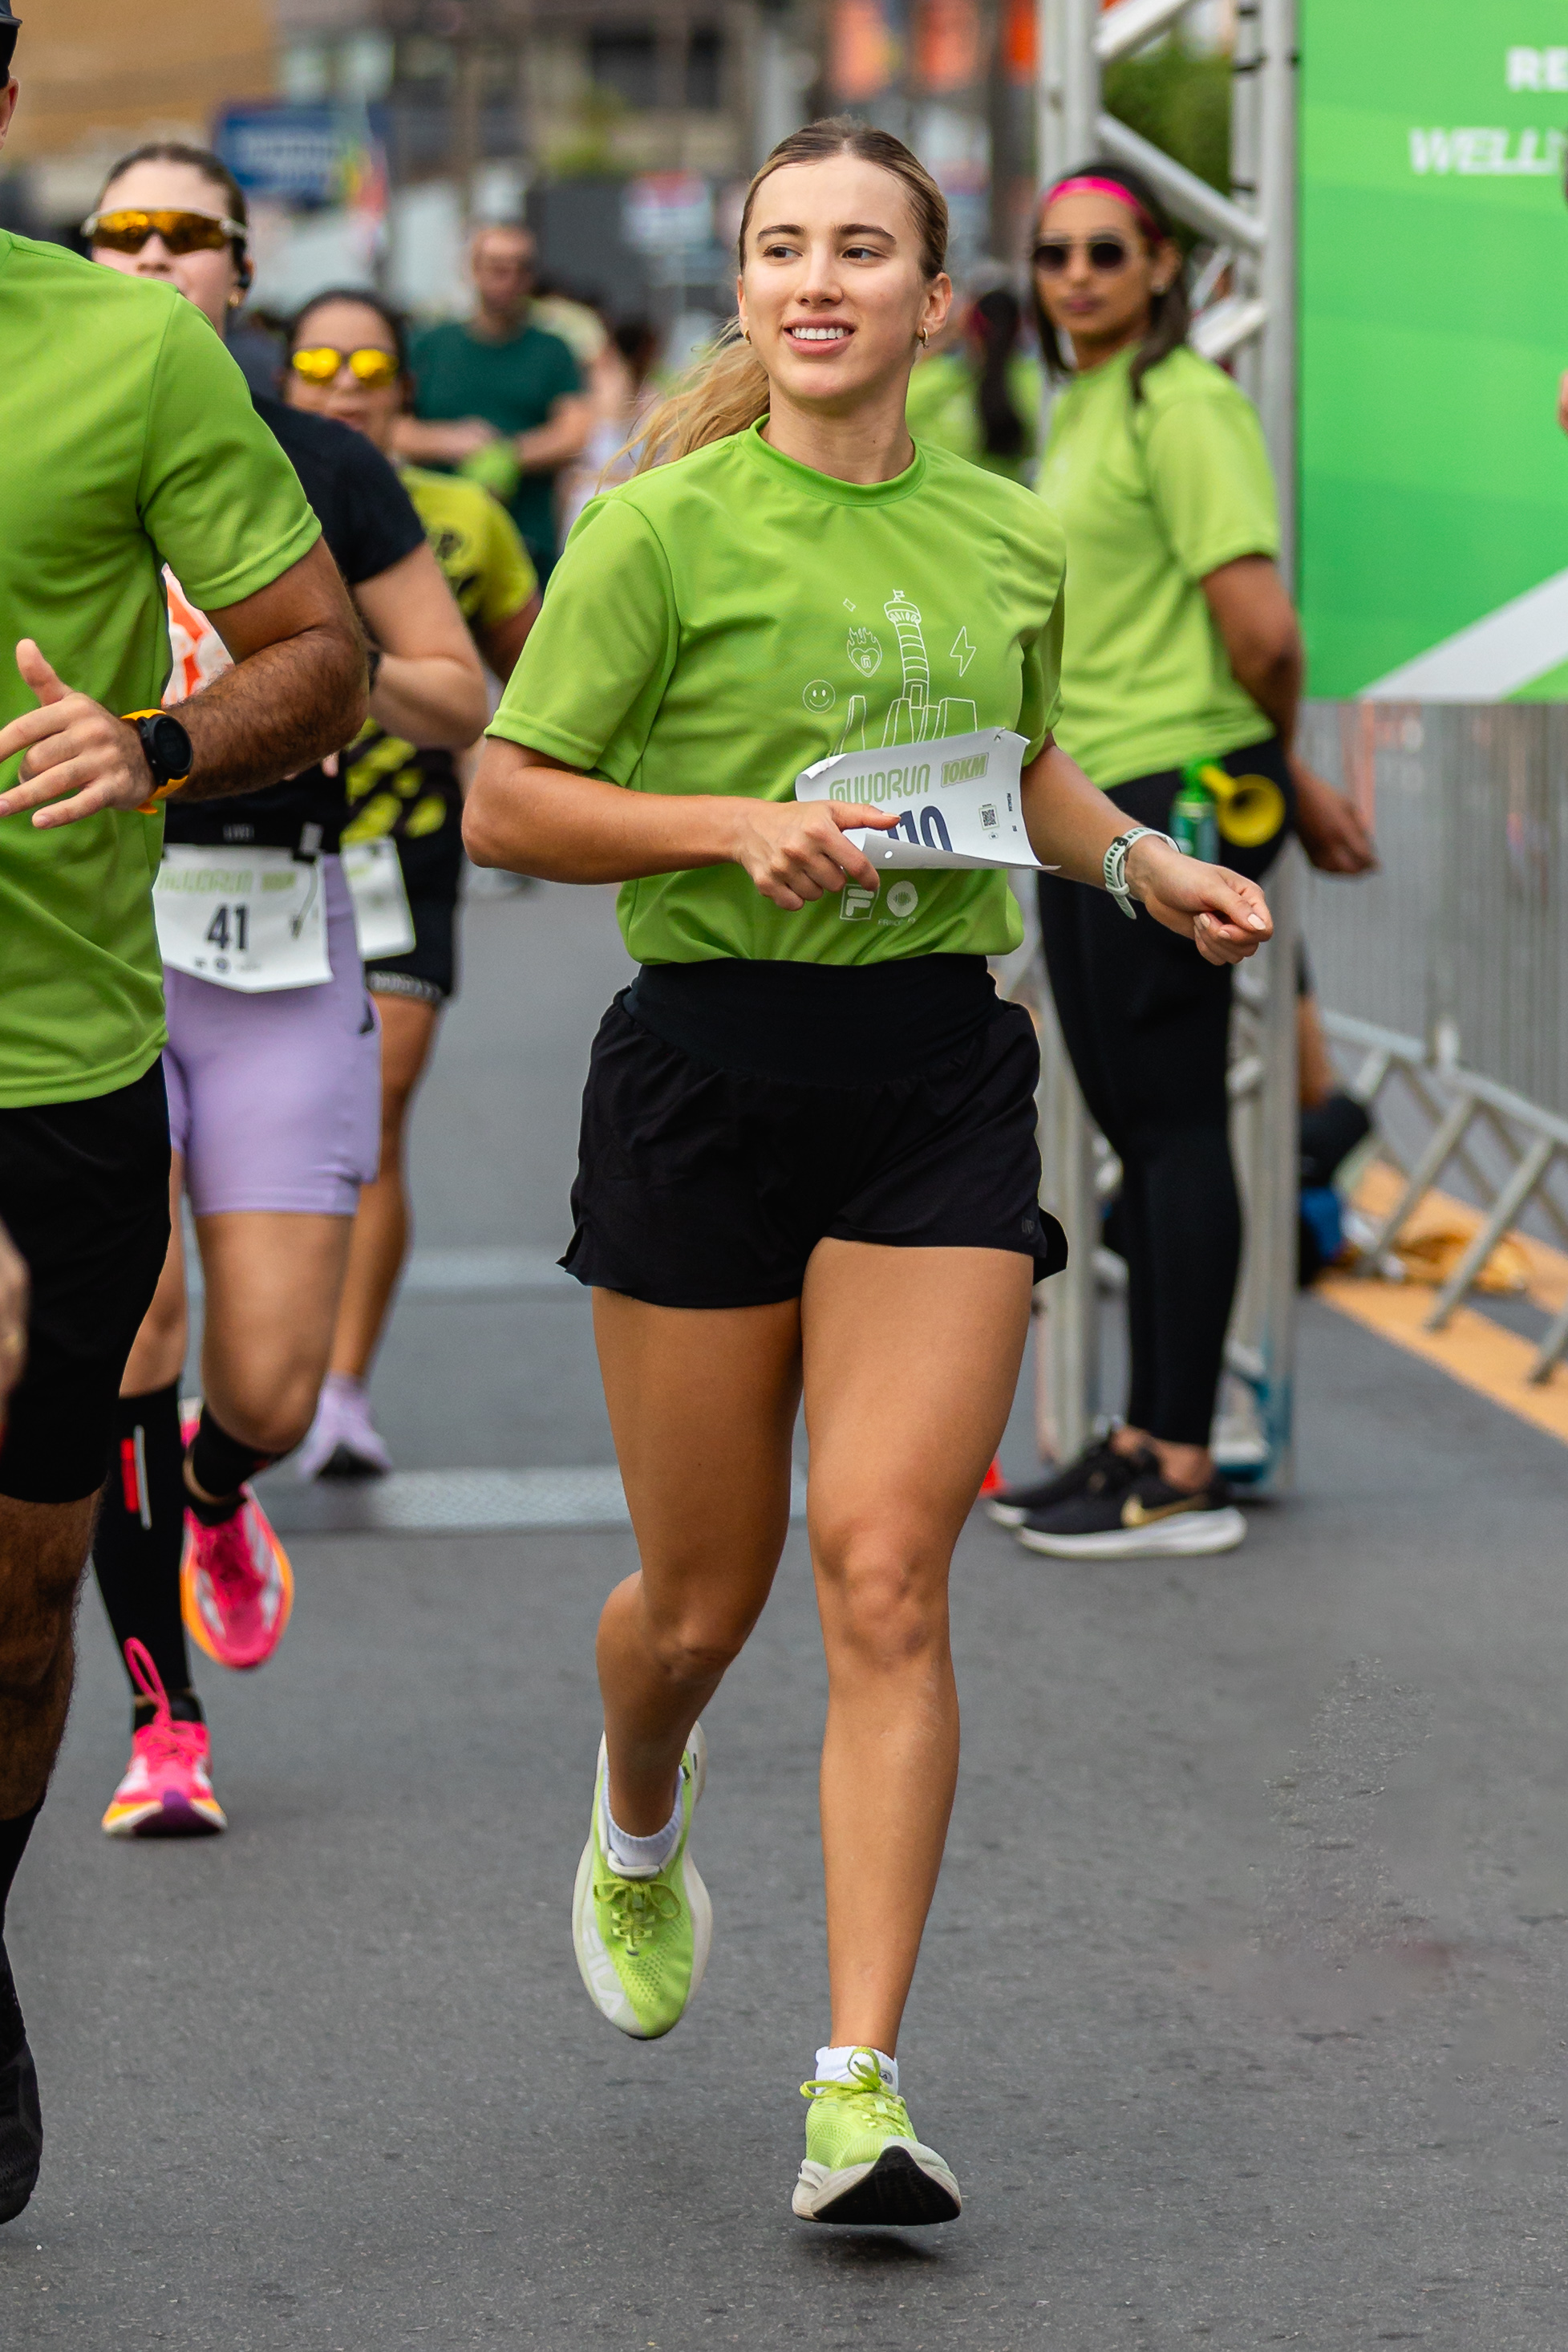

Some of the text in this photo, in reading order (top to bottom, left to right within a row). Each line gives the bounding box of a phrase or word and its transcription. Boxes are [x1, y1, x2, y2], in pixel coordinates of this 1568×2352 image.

[942, 755, 987, 785] 10KM
[886, 805, 954, 853] 10
[206, 904, 248, 951] 41
